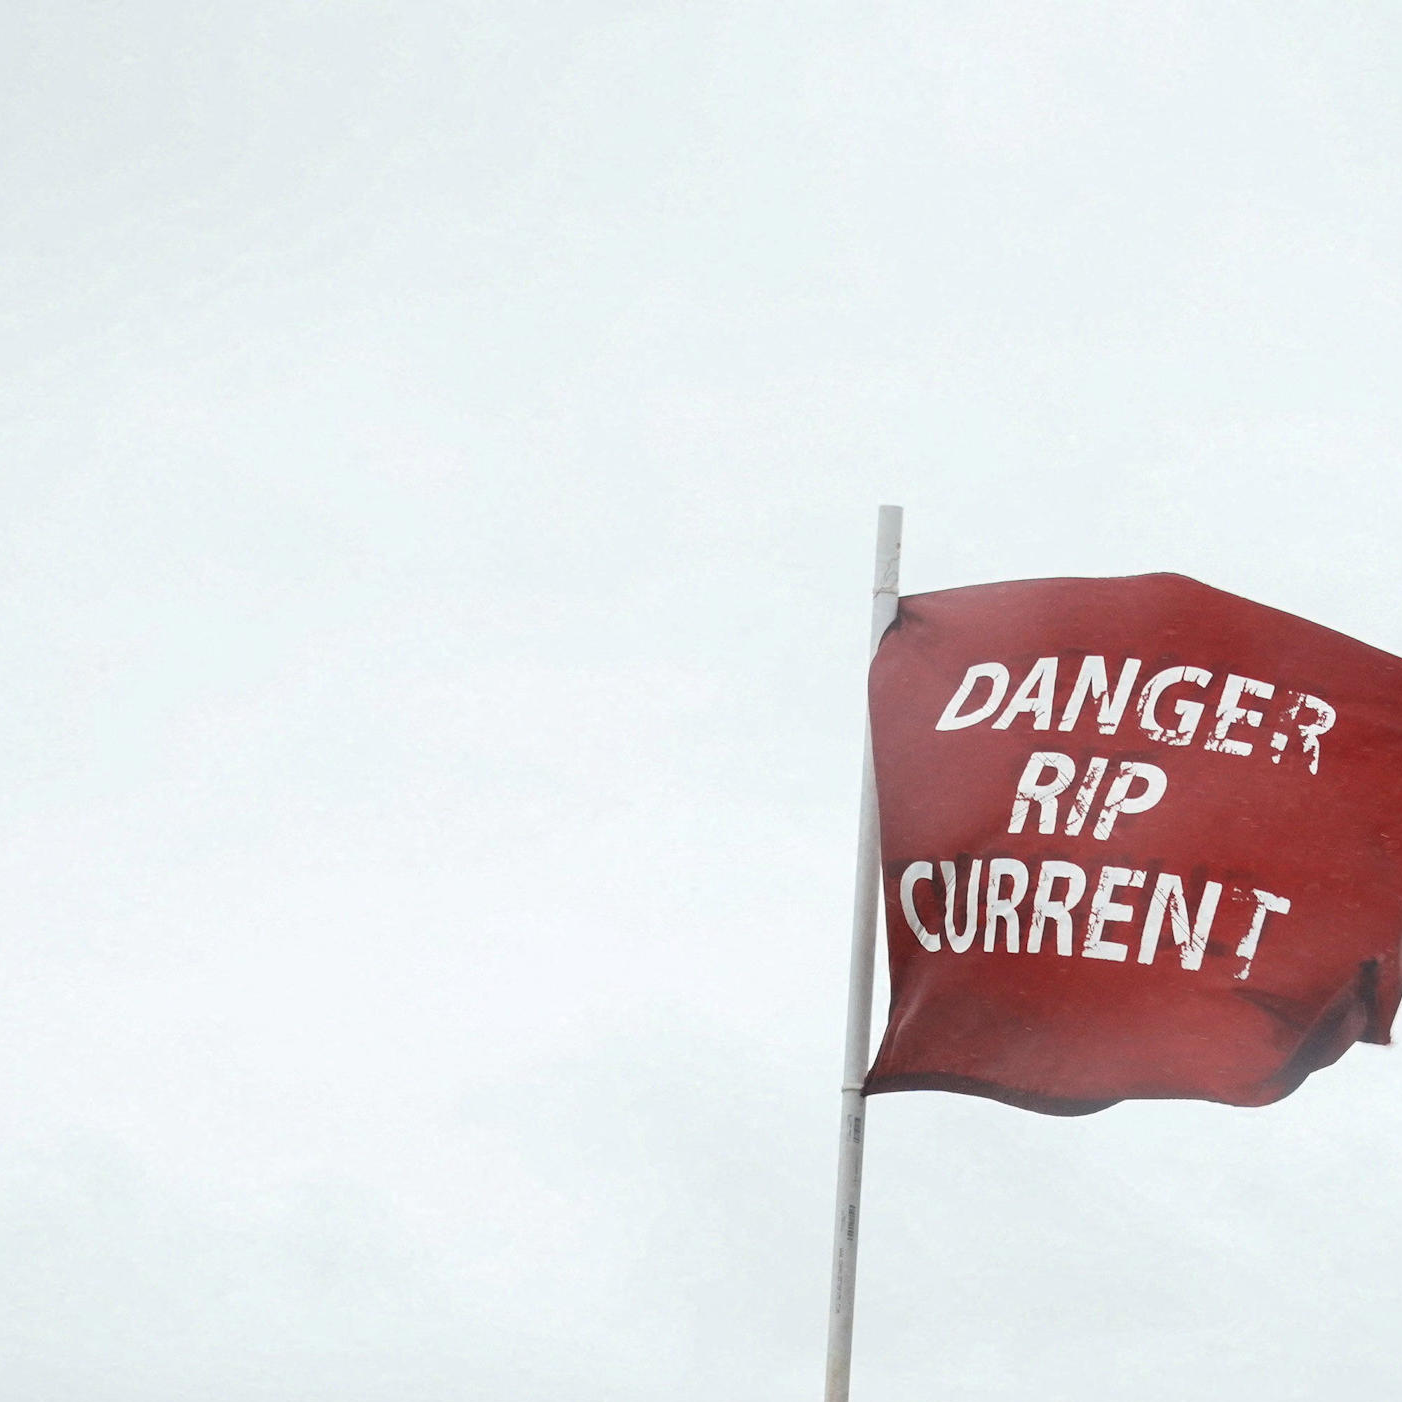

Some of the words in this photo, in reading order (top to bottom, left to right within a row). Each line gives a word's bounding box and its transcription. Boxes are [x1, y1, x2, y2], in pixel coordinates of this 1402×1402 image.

[935, 655, 1337, 775] DANGER
[1007, 752, 1168, 840] RIP
[900, 858, 1290, 980] CURRENT
